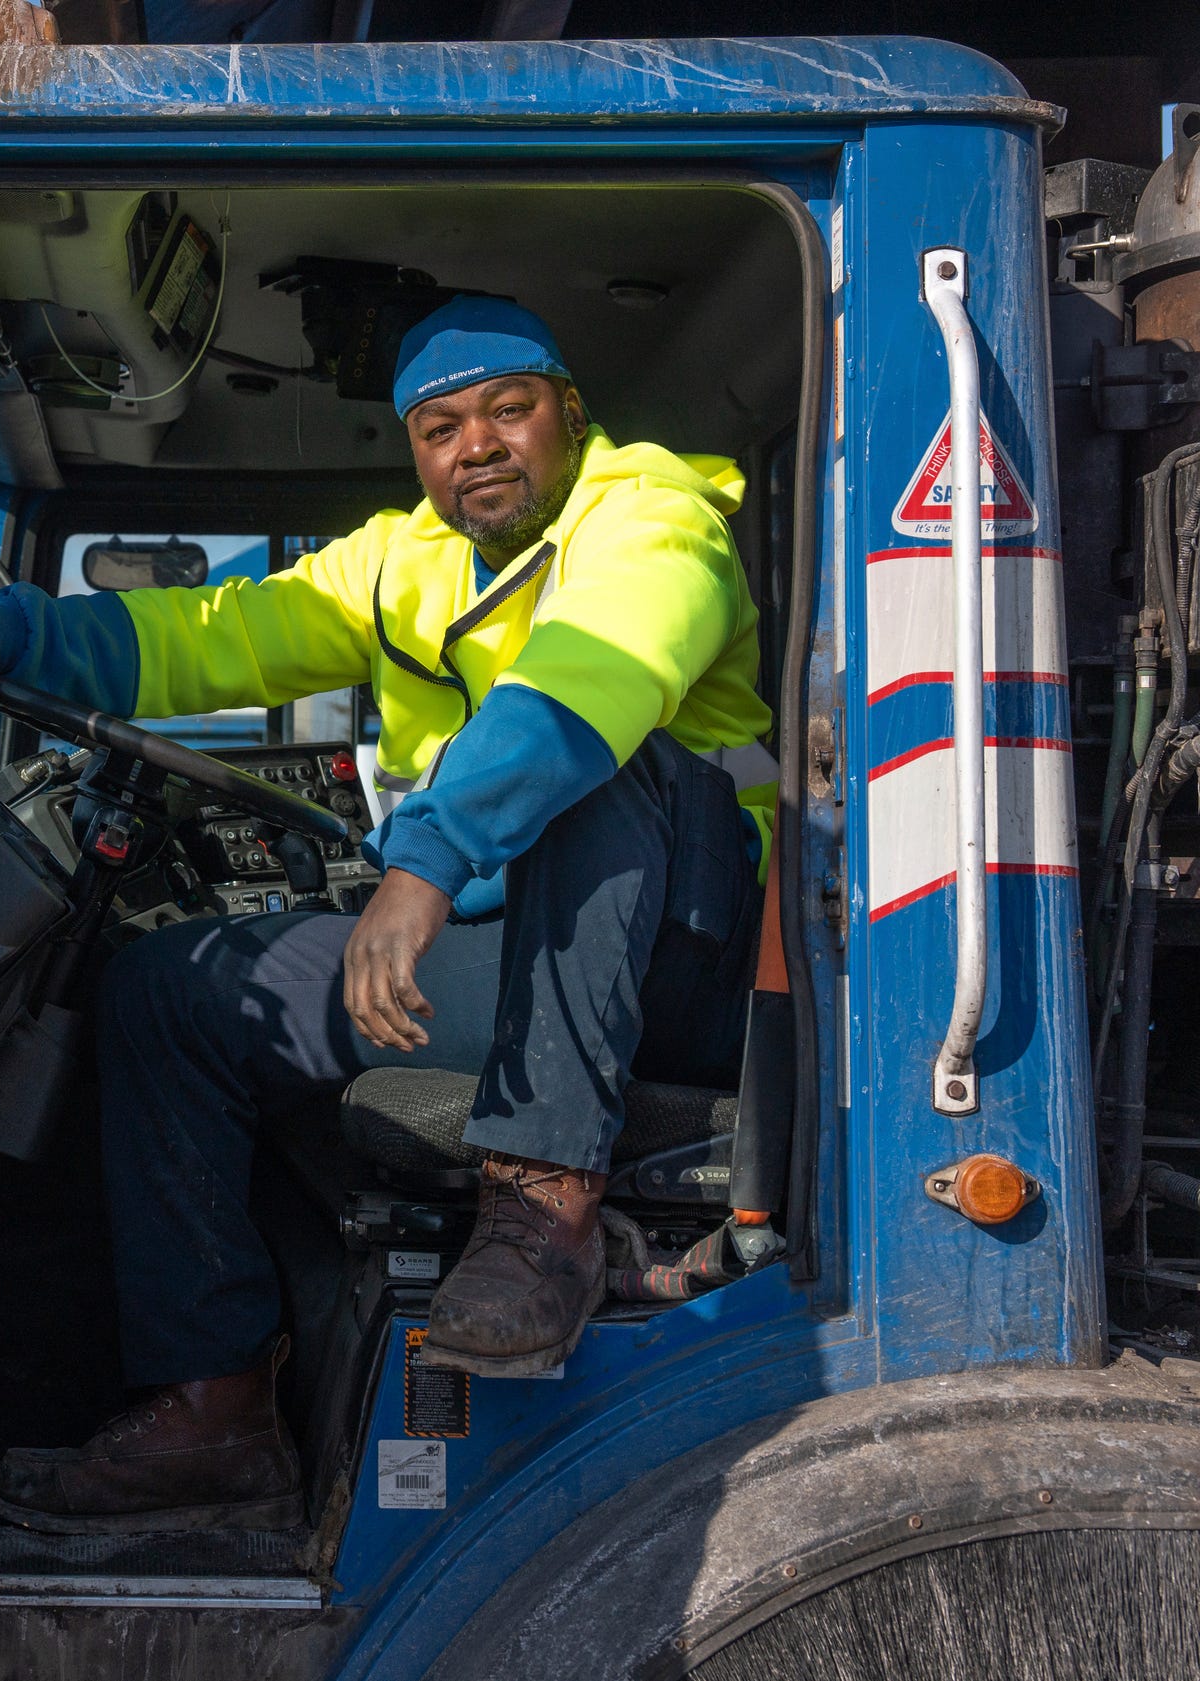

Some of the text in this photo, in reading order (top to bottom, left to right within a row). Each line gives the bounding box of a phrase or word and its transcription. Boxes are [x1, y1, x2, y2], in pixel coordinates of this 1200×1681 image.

[417, 366, 485, 394] REPUBLIC SERVICES
[924, 442, 952, 478] THINK
[980, 435, 1013, 488] CHOOSE
[932, 485, 999, 502] SATY
[915, 523, 1018, 535] It's the Thing!
